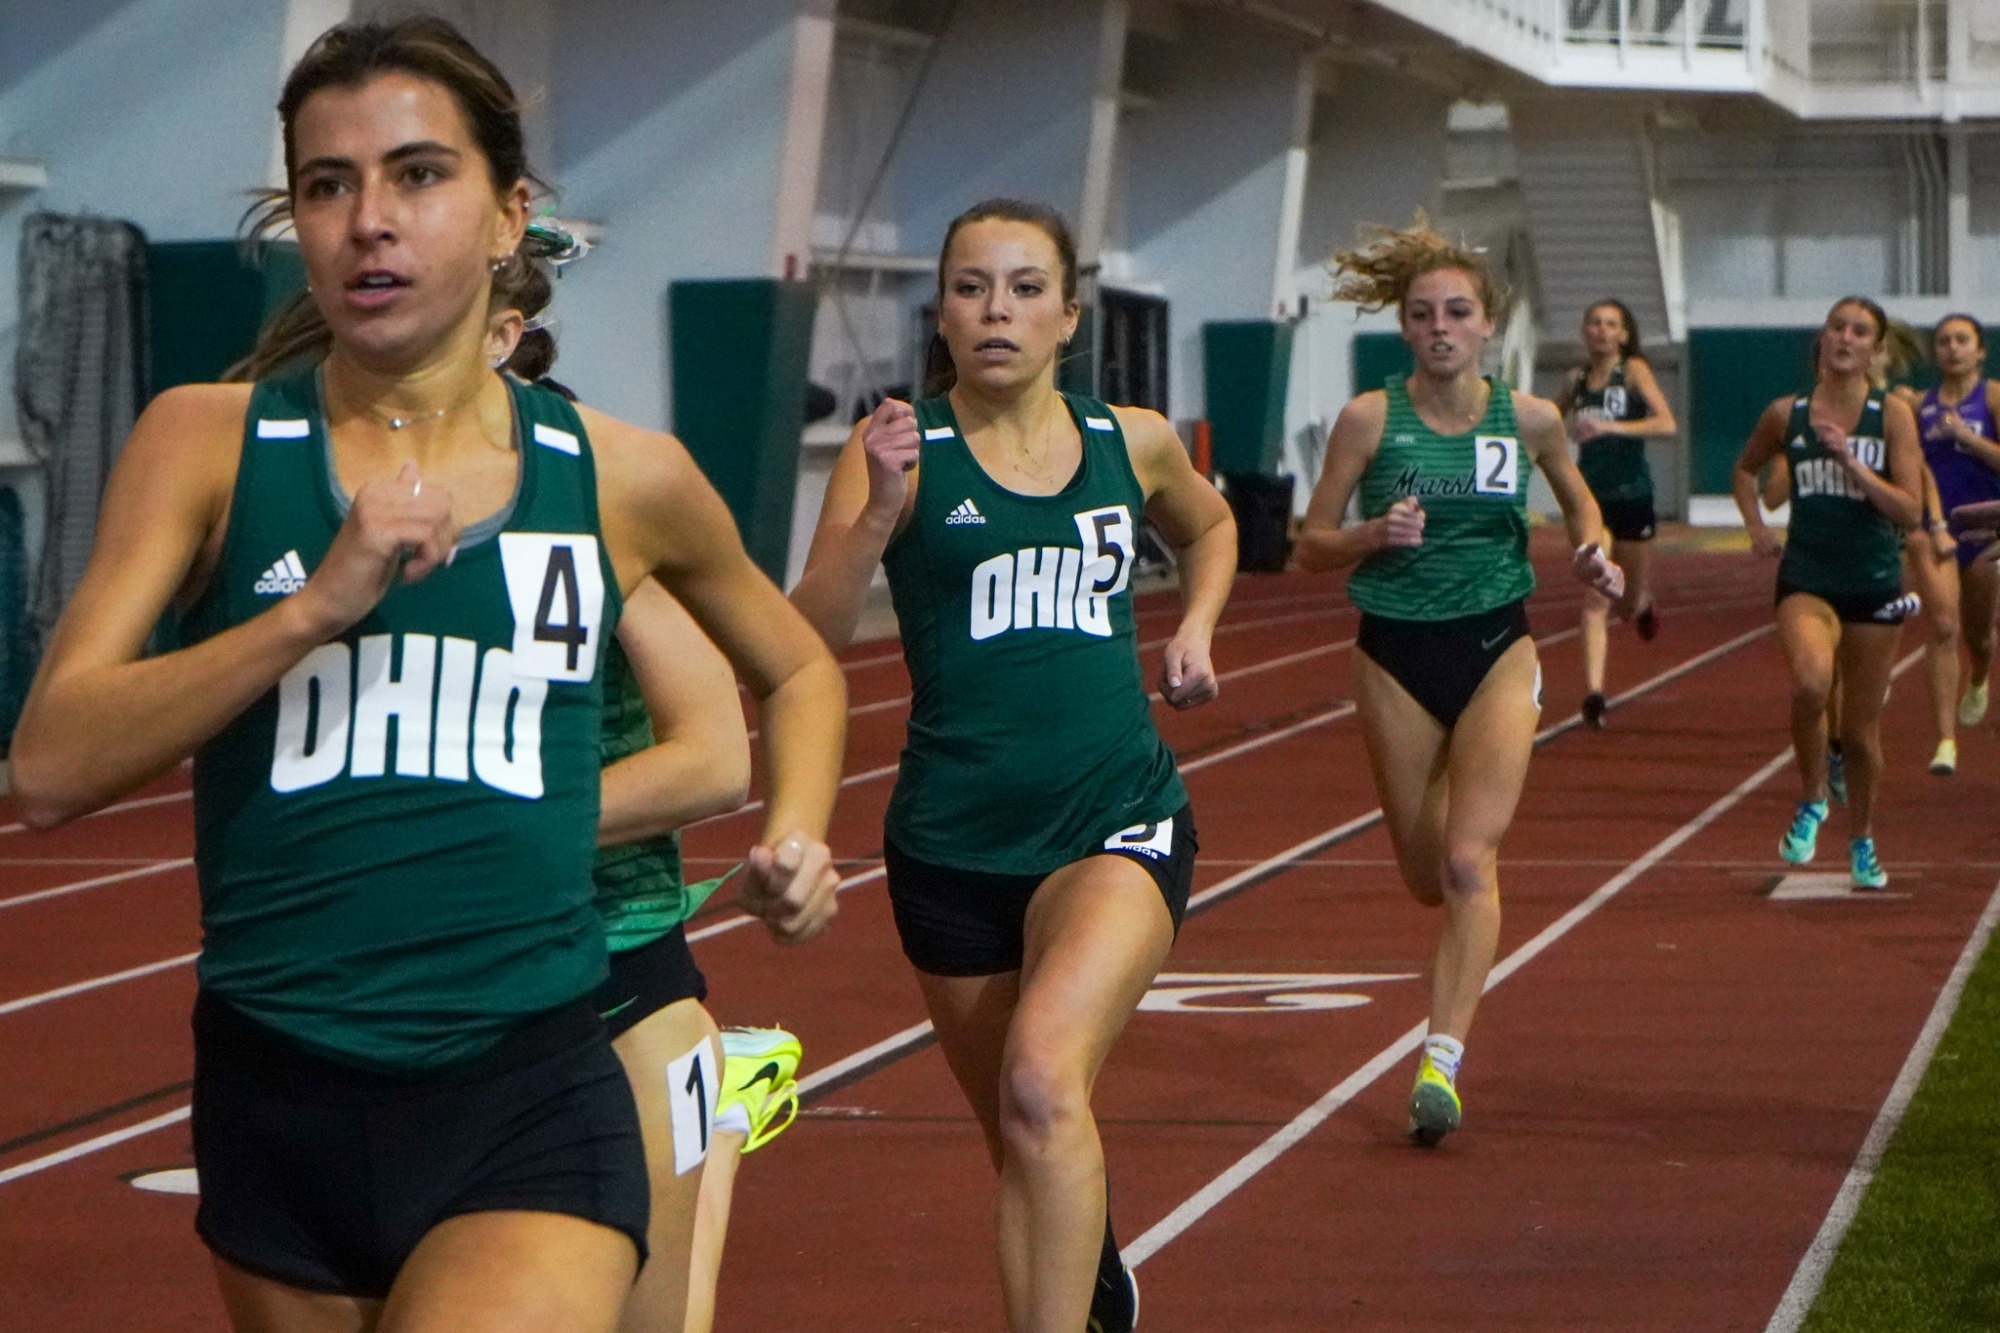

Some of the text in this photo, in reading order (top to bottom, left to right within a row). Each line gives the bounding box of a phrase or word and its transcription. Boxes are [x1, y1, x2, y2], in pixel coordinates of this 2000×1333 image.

[1386, 463, 1477, 497] Marsh
[1485, 440, 1509, 489] 2
[945, 514, 986, 524] adidas
[1091, 511, 1125, 593] 5
[254, 578, 306, 594] adida
[533, 545, 588, 671] 4
[271, 633, 547, 799] OHIO
[685, 1053, 708, 1153] 1
